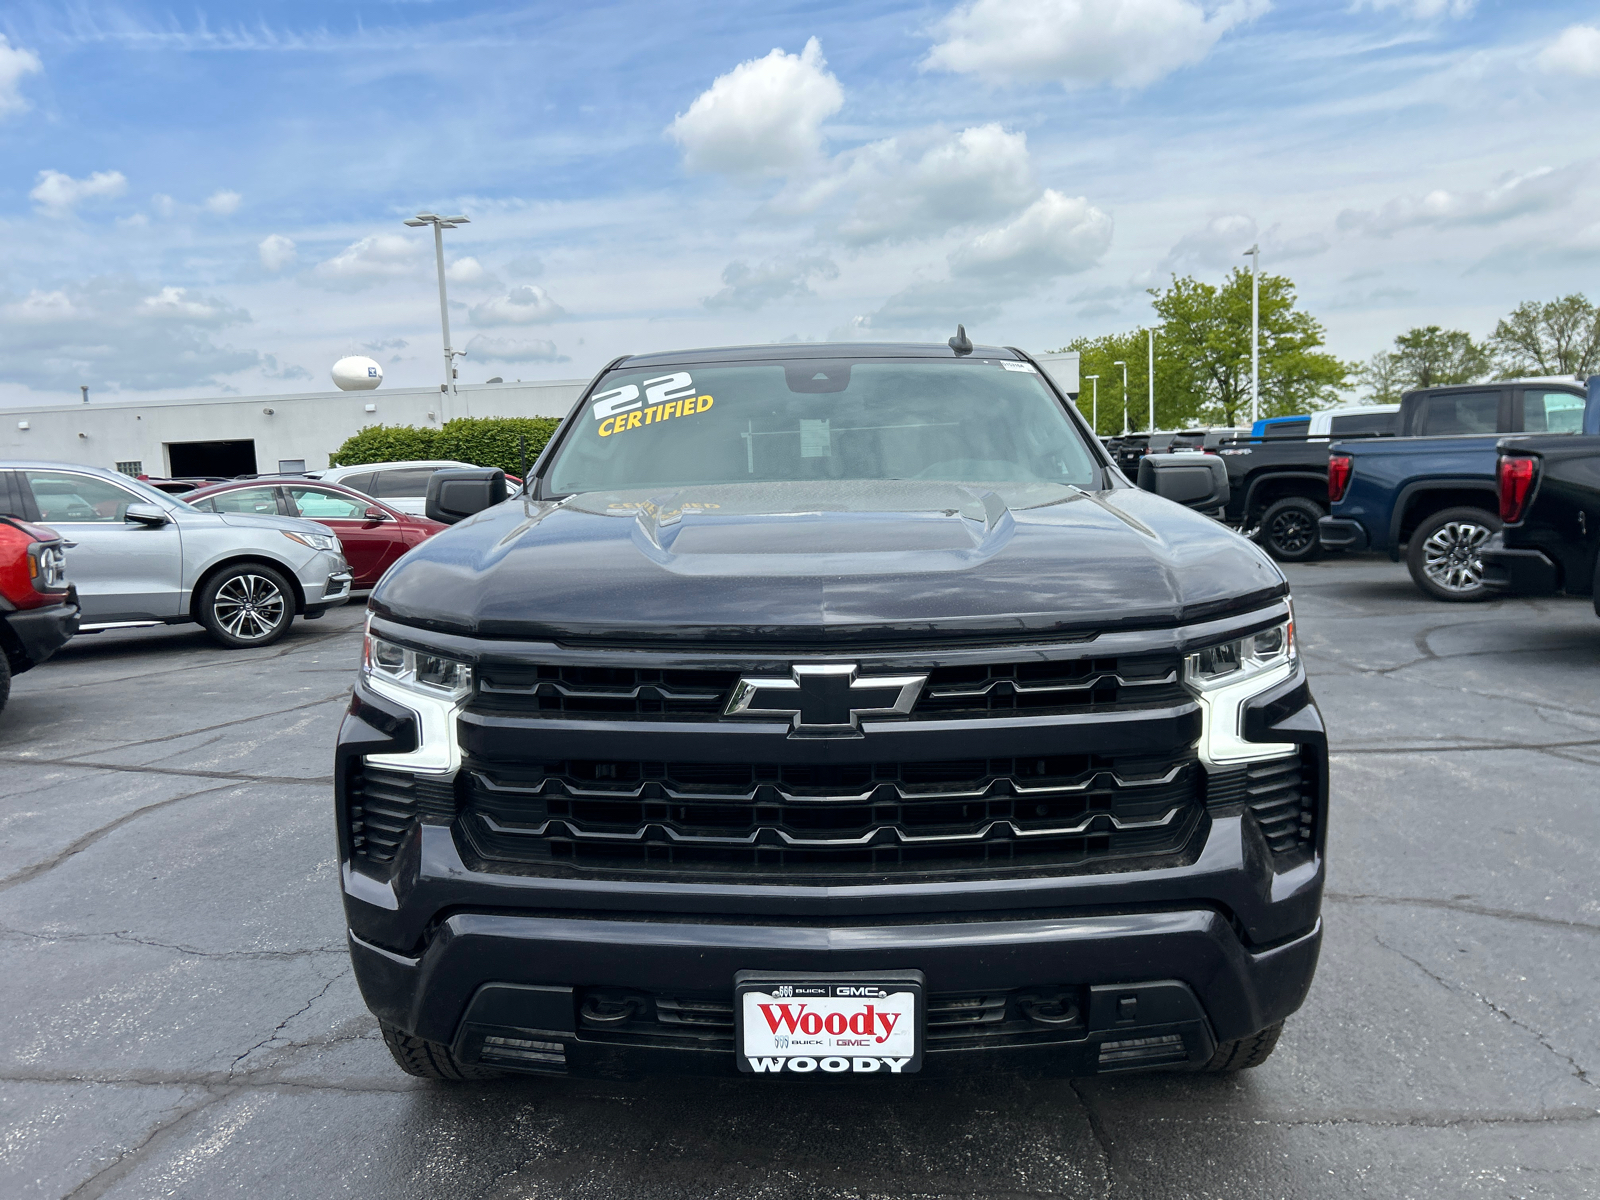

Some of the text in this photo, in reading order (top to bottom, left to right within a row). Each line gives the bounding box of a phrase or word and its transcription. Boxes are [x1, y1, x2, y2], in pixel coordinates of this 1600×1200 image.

[591, 371, 696, 421] 22
[598, 394, 714, 437] CERTIFIED
[836, 986, 879, 996] GMC
[757, 1003, 902, 1044] Woody
[836, 1039, 871, 1047] GMC
[747, 1057, 911, 1073] WOODY
